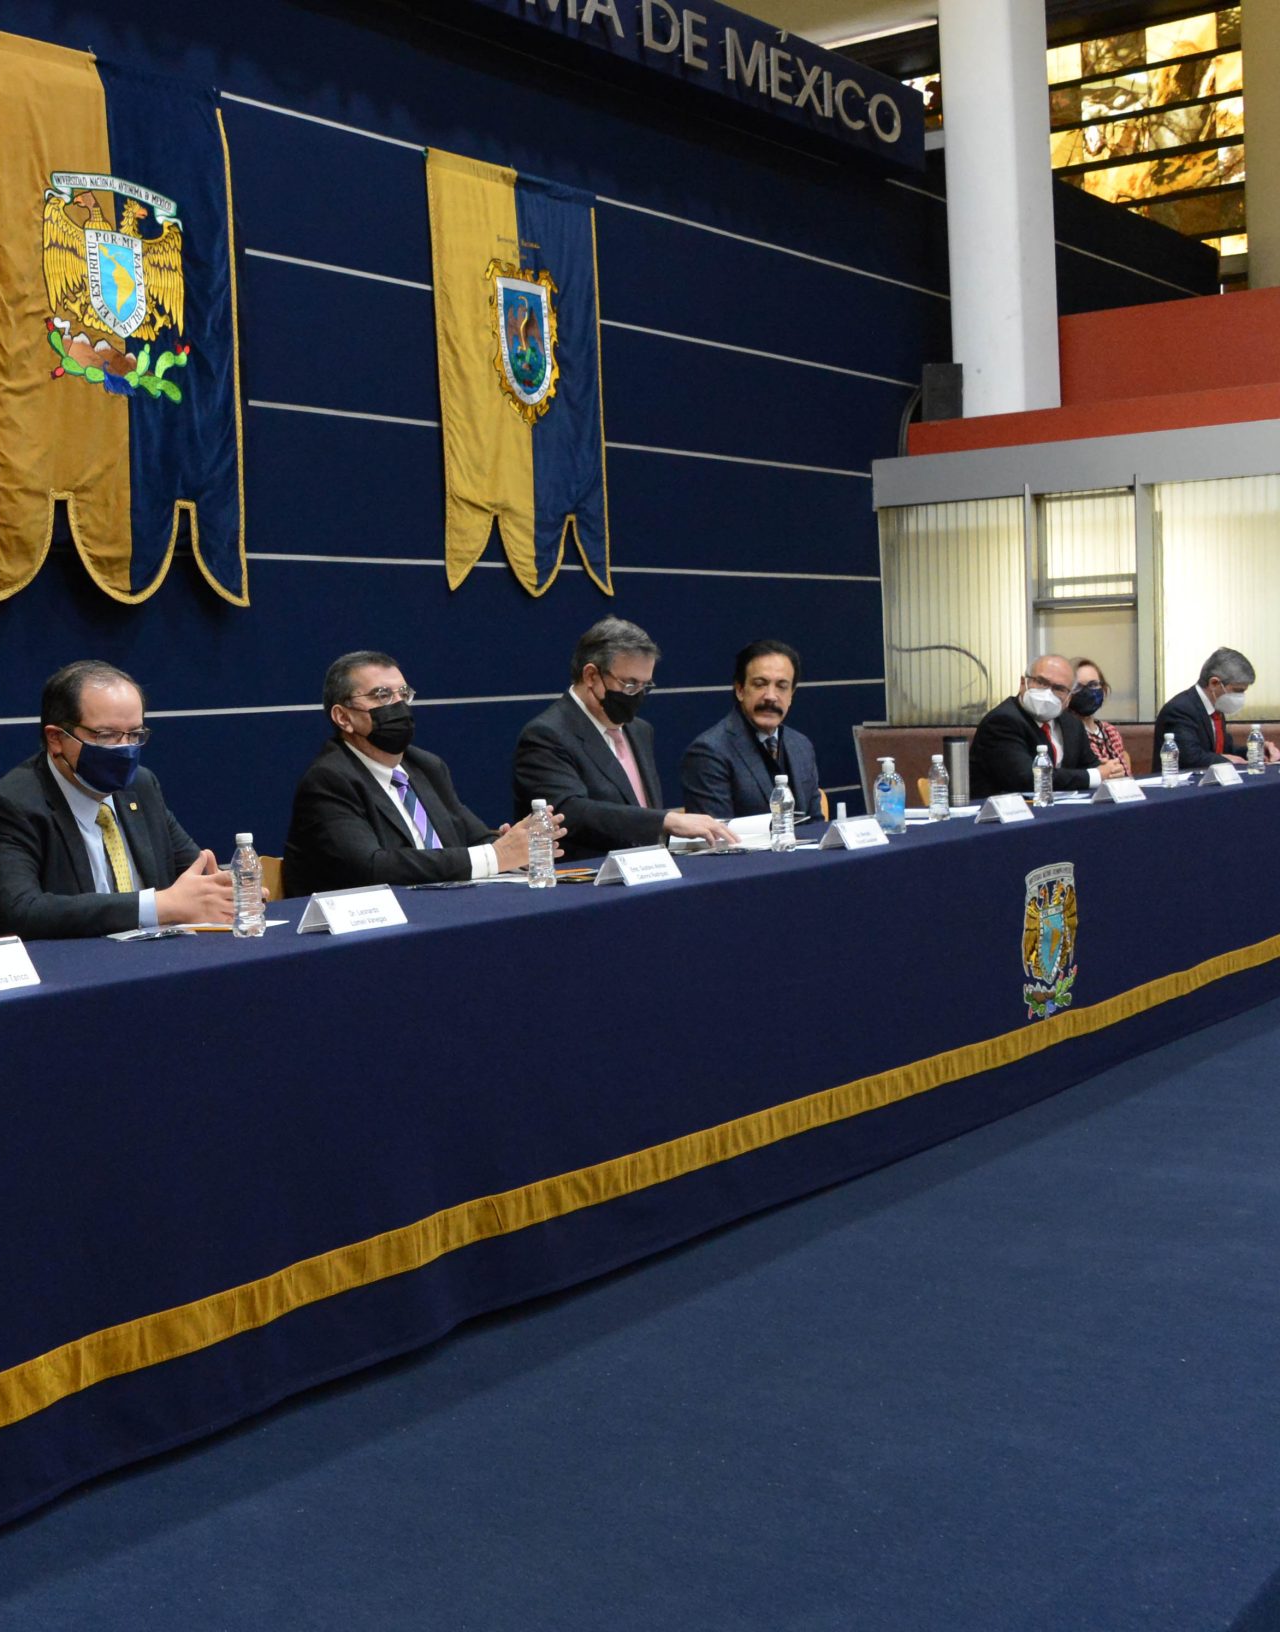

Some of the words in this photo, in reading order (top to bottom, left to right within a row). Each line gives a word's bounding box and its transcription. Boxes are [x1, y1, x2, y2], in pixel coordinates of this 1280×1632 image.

[642, 0, 708, 70] DE
[724, 27, 901, 143] MÉXICO
[95, 231, 118, 244] POR
[122, 237, 134, 249] MI
[87, 241, 101, 298] ESPIRITU
[133, 252, 144, 287] RAZA
